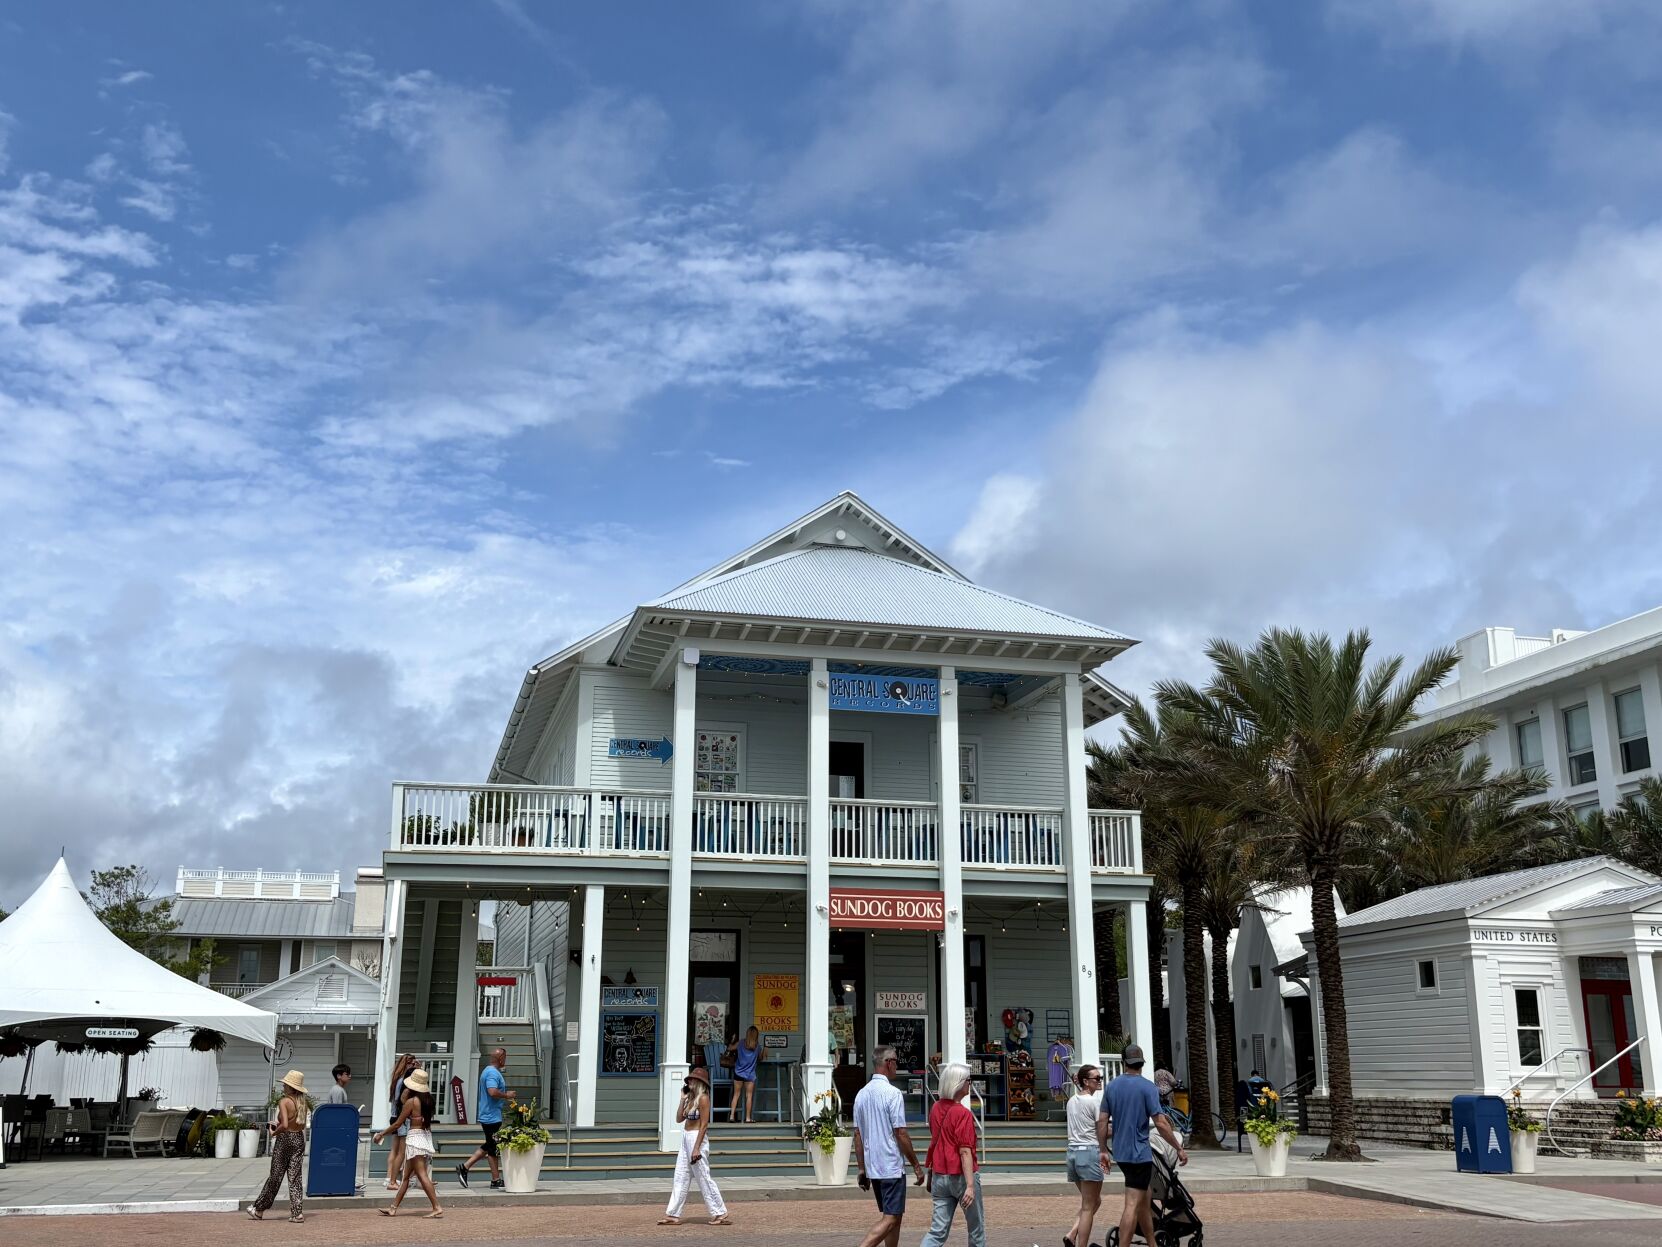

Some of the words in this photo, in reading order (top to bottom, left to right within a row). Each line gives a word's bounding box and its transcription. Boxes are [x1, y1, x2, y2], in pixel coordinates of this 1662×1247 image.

[831, 678, 880, 699] CENTRAL
[882, 681, 937, 702] SQUARE
[832, 699, 936, 710] RECORDS
[830, 899, 892, 917] SUNDOG
[897, 901, 942, 918] BOOKS
[1473, 930, 1514, 941] UNITED
[1519, 932, 1558, 942] STATES
[1082, 964, 1092, 979] 89
[757, 980, 797, 989] SUNDOG
[604, 988, 628, 998] CENTRAL
[879, 993, 923, 1001] SUNDOG
[760, 1016, 792, 1025] BOOKS
[454, 1085, 465, 1120] OPEN
